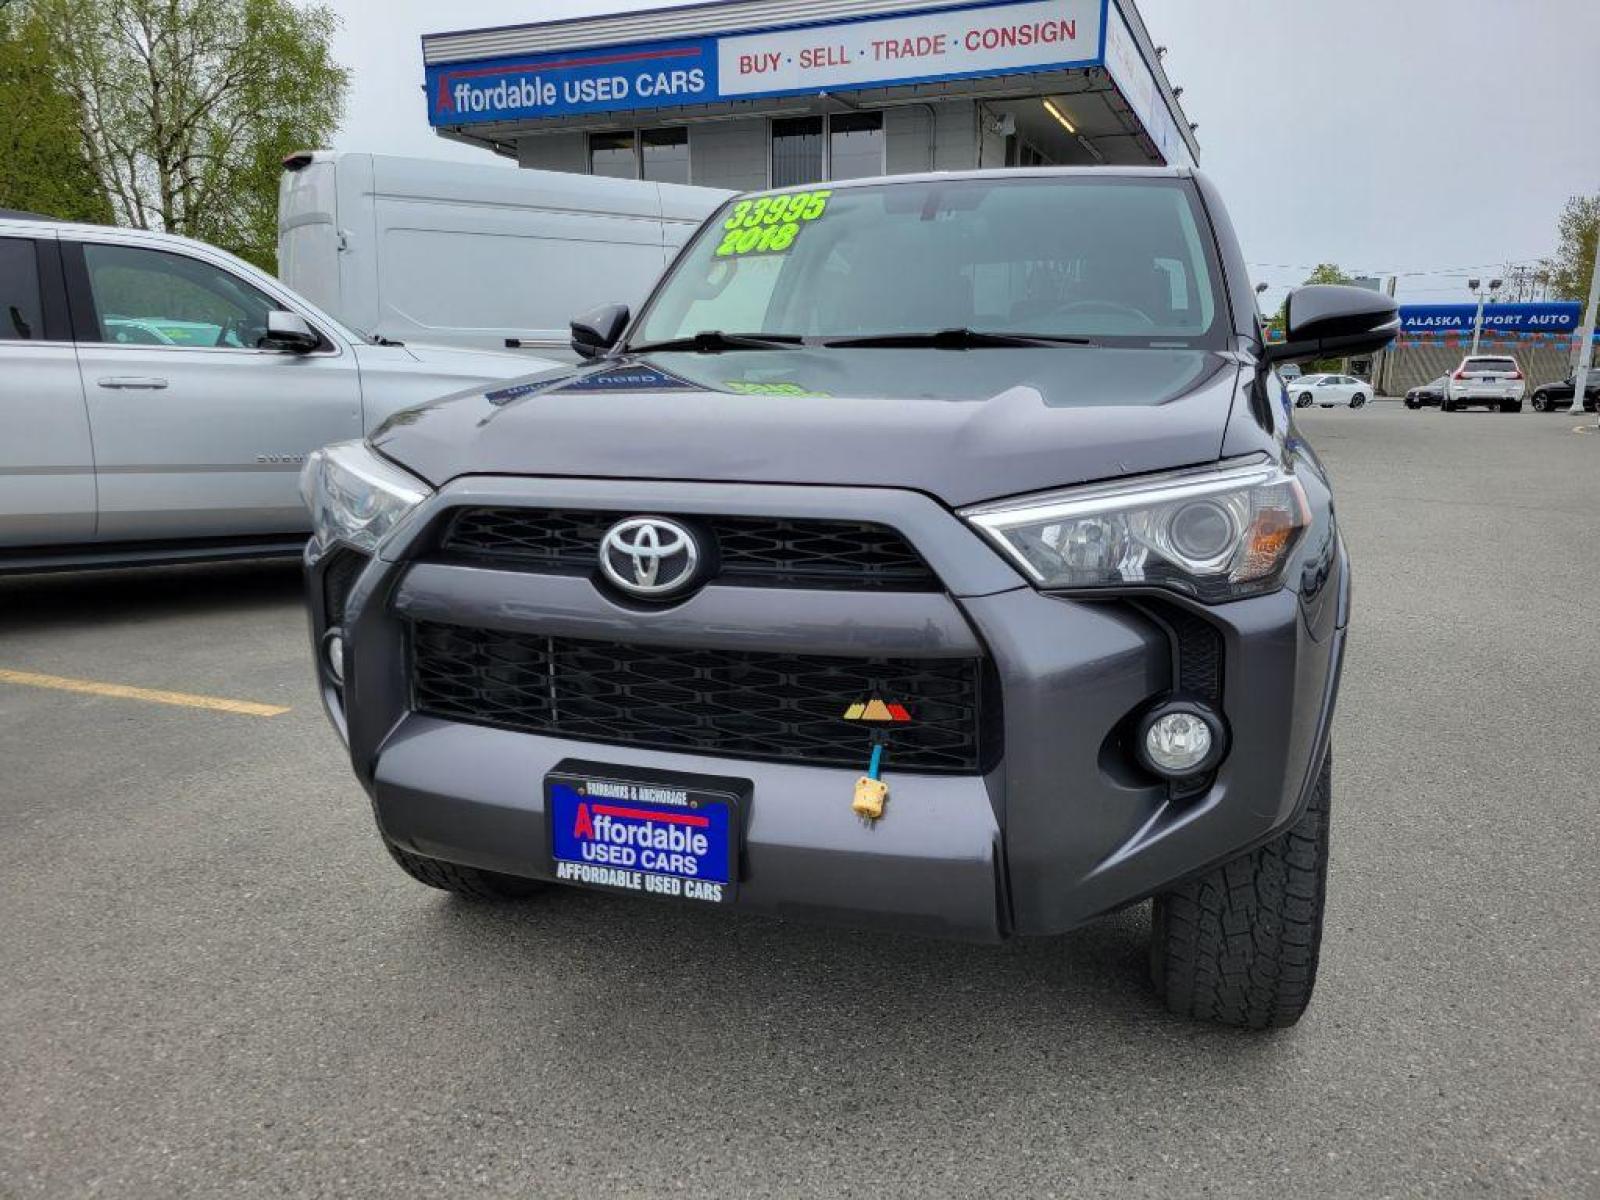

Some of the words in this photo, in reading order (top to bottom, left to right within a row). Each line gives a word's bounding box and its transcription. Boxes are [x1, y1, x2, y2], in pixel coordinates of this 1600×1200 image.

[739, 52, 781, 75] BUY
[799, 45, 851, 69] SELL
[871, 34, 946, 61] TRADE
[964, 19, 1076, 51] CONSIGN
[436, 73, 557, 113] Affordable
[564, 76, 630, 104] USED
[635, 68, 706, 98] CARS
[724, 190, 832, 229] 33995
[716, 223, 799, 256] 2018
[1405, 315, 1462, 326] ALASKA
[1527, 314, 1571, 325] AUTO
[631, 786, 638, 801] &
[574, 803, 709, 856] Affordable
[581, 841, 637, 866] USED
[640, 851, 698, 876] CARS
[556, 861, 642, 890] AFFORDABLE
[644, 874, 681, 897] USED
[685, 880, 723, 902] CARS
